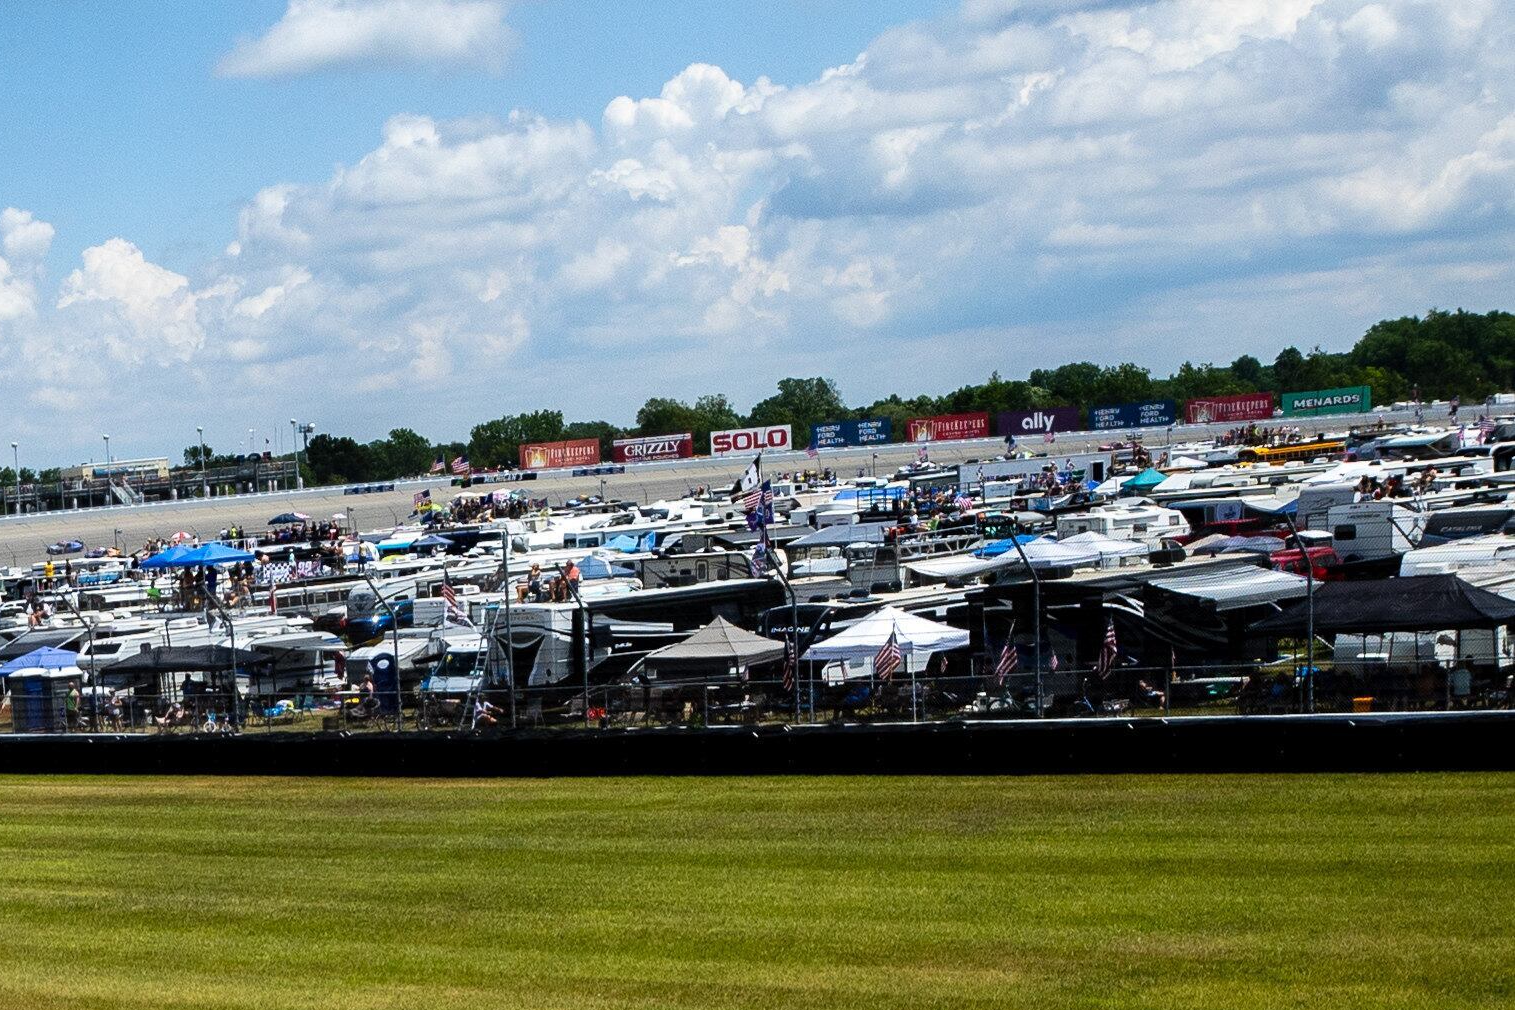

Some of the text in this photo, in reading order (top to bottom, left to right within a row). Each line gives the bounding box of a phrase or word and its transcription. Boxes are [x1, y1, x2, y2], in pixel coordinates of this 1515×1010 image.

[1293, 394, 1361, 409] MENARDS
[1139, 403, 1165, 411] HENRY
[1140, 410, 1160, 418] FORD
[1021, 411, 1055, 431] ally
[1140, 416, 1170, 424] HEALTH
[816, 425, 841, 433] HENRY
[858, 421, 882, 429] HENRY
[712, 428, 788, 453] SOLO
[859, 433, 886, 442] HEALTH
[818, 438, 845, 446] HEALTH
[623, 440, 680, 458] GRIZZLY
